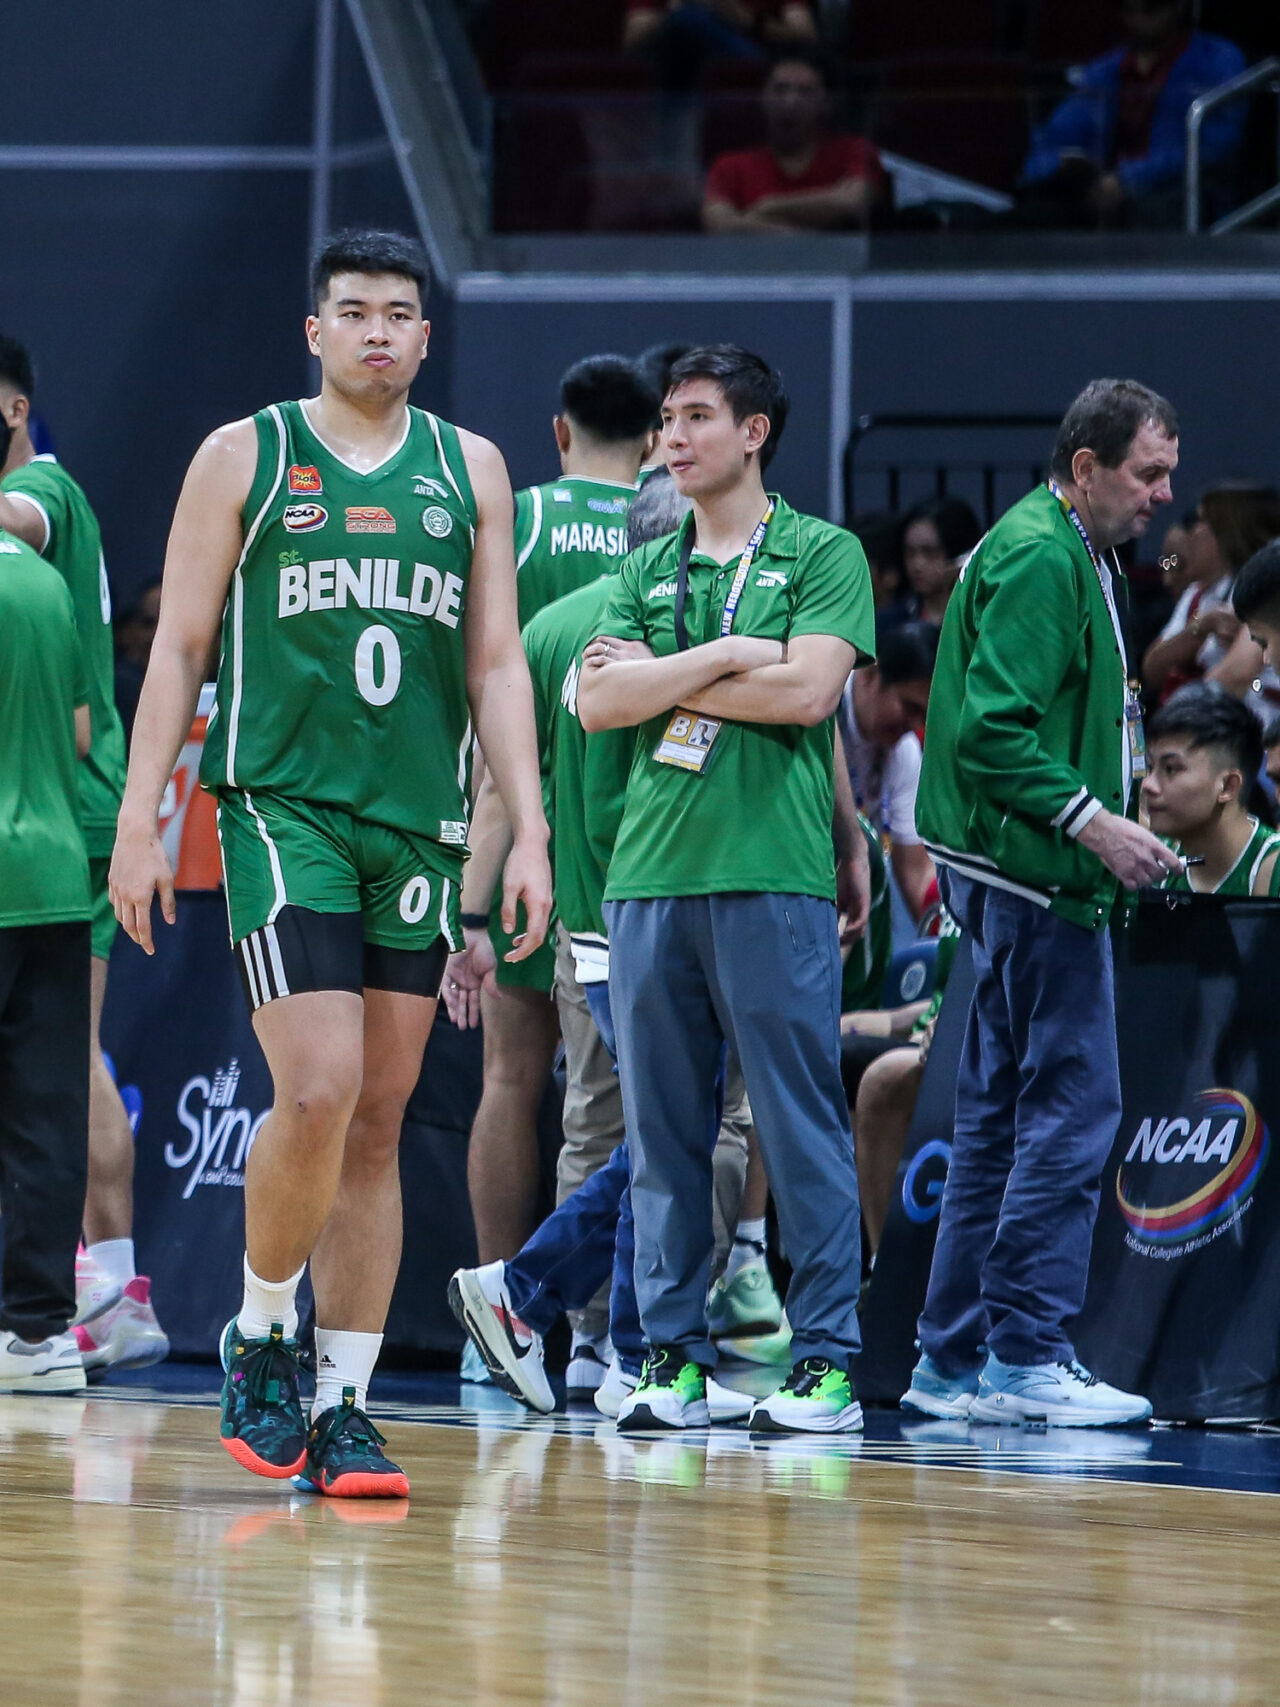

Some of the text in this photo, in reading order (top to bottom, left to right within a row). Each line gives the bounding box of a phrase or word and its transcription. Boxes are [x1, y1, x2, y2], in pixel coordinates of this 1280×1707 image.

[285, 509, 316, 518] NCAA
[278, 558, 464, 629] BENILDE
[355, 624, 401, 706] 0
[670, 716, 691, 738] B
[399, 876, 430, 924] 0
[1124, 1116, 1239, 1164] NCAA
[1124, 1196, 1254, 1262] National Collegiate Athletic Association
